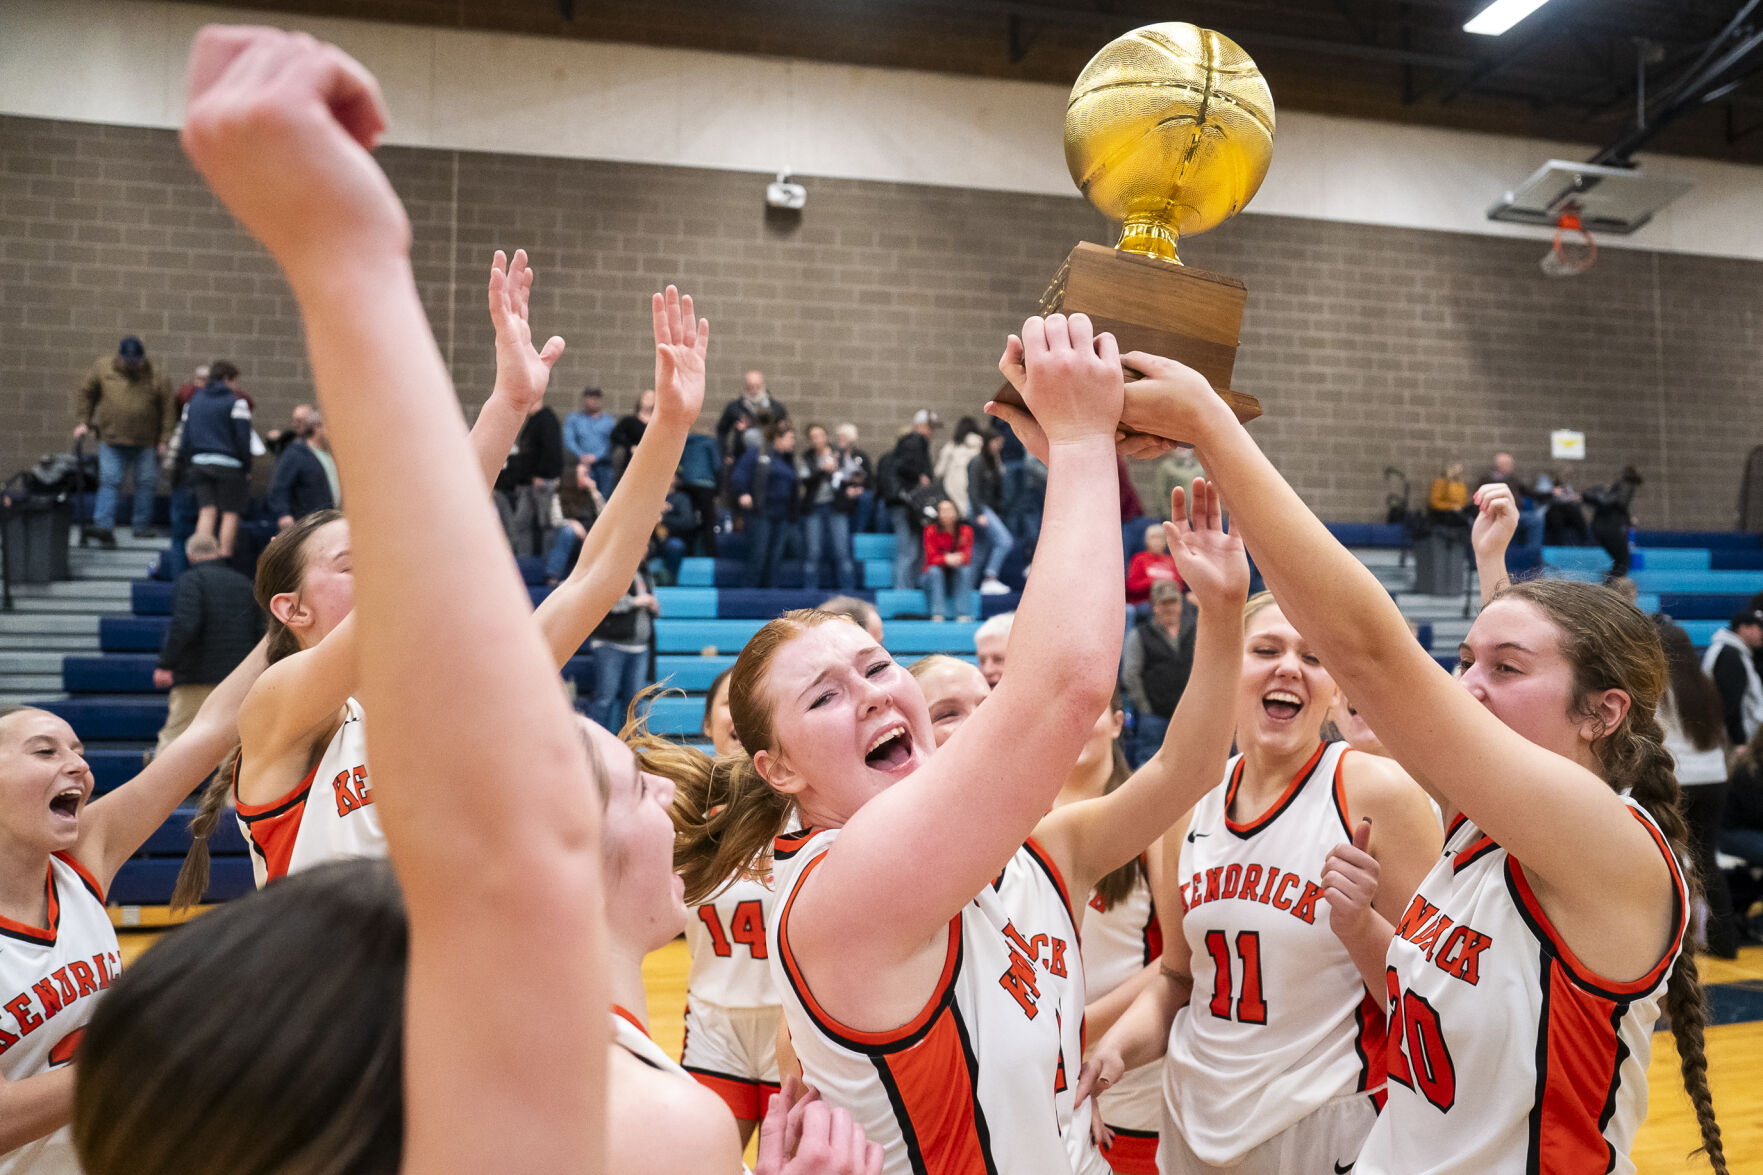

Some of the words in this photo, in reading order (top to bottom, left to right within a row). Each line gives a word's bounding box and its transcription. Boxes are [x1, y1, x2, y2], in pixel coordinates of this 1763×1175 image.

[697, 899, 769, 960] 14
[1179, 863, 1326, 925] KENDRICK
[1204, 929, 1268, 1026] 11
[1386, 965, 1456, 1115] 20
